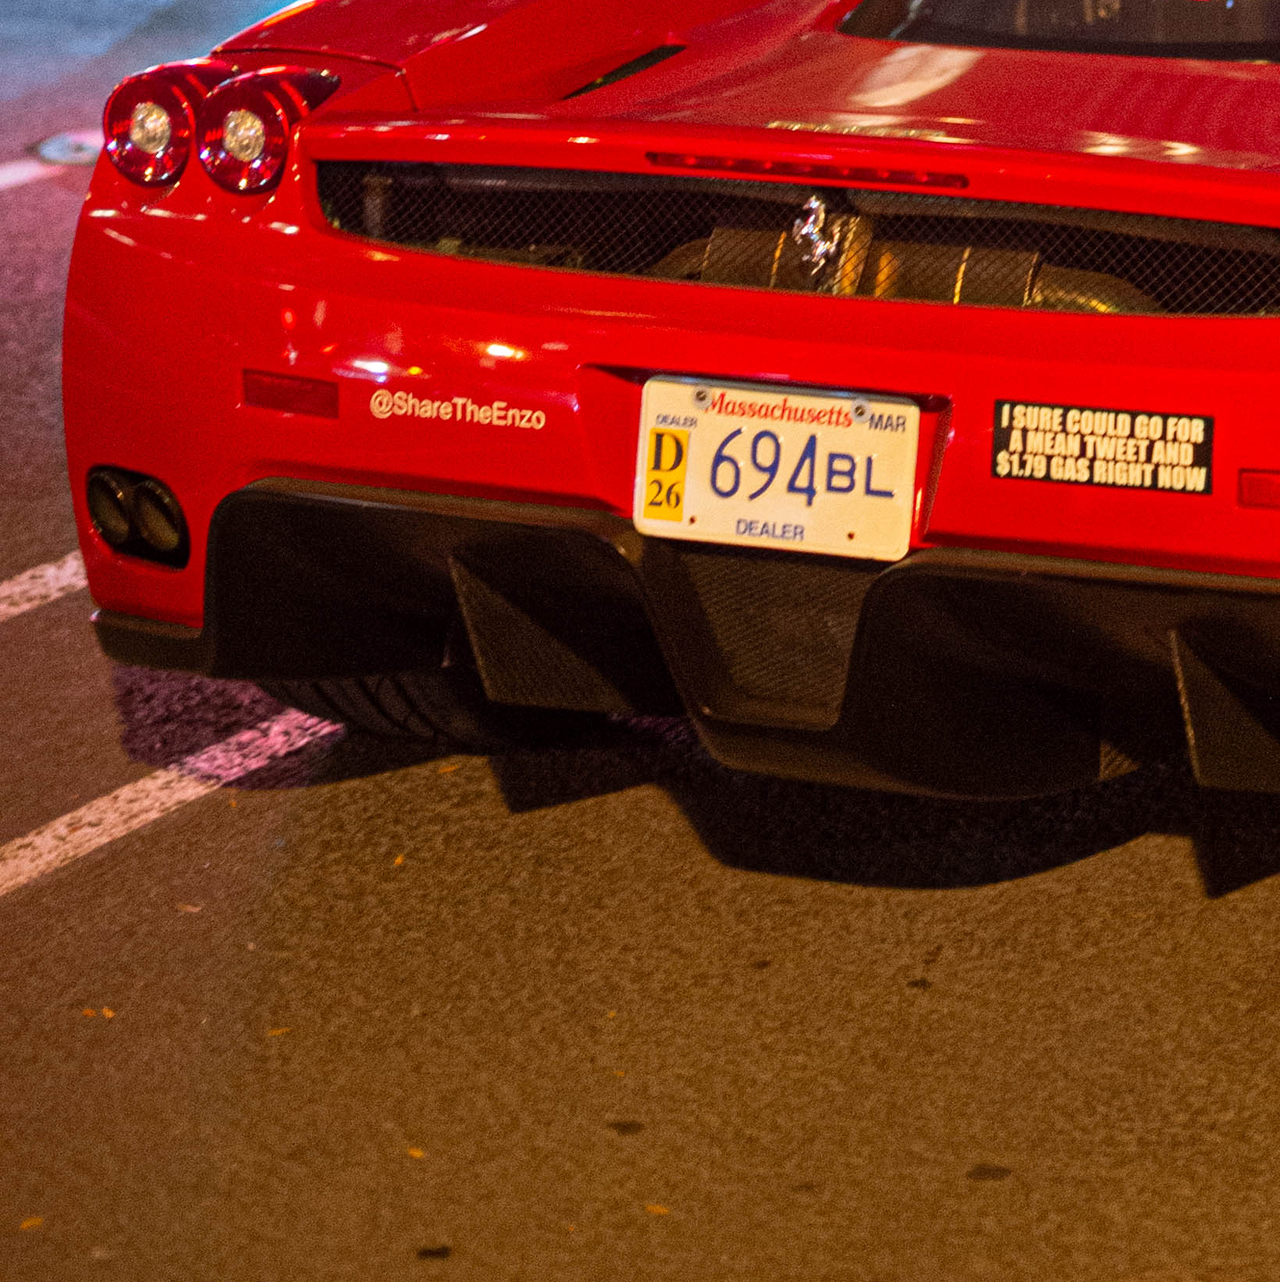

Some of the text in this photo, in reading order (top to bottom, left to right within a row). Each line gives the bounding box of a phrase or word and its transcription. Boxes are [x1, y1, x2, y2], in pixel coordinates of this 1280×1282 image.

[369, 388, 546, 430] @ShareTheEnzo
[656, 413, 697, 428] DEALER
[705, 391, 852, 428] Massachusetts
[868, 413, 906, 433] MAR
[1001, 403, 1204, 443] I SURE COULD GO FOR
[651, 433, 683, 473] D
[1009, 428, 1194, 466] A MEAN TWEET AND
[710, 426, 894, 507] 694BL
[996, 450, 1207, 491] $1.79 GAS RIGHT NOW
[648, 480, 681, 509] 26
[735, 517, 804, 541] DEALER
